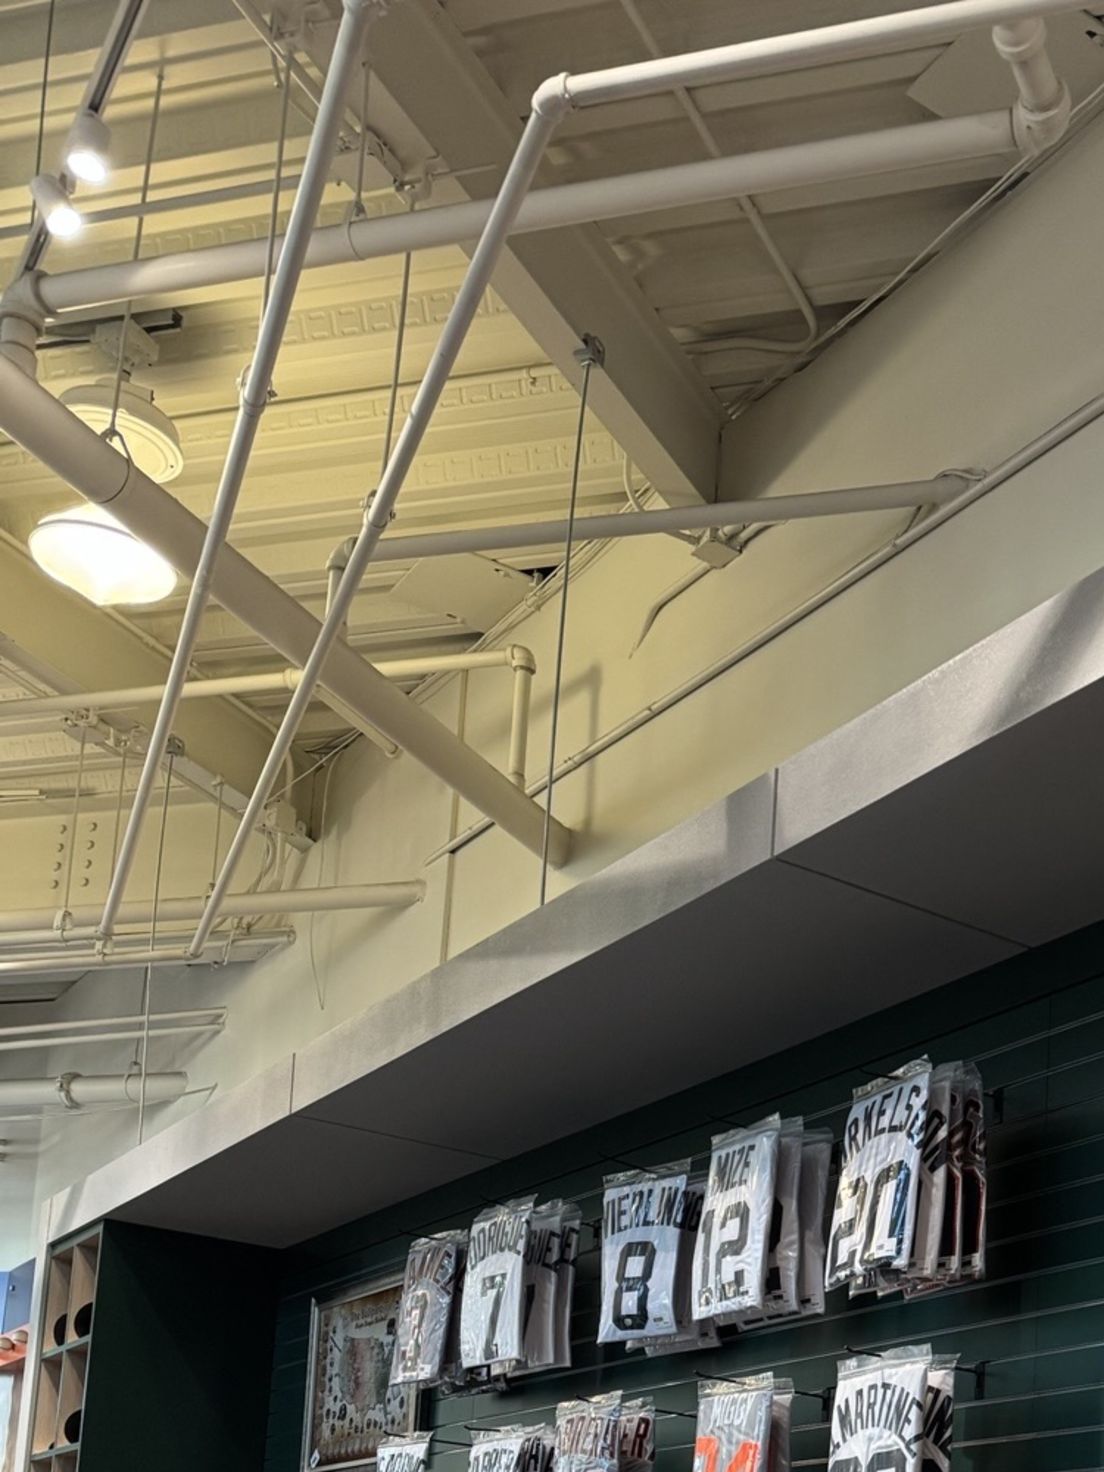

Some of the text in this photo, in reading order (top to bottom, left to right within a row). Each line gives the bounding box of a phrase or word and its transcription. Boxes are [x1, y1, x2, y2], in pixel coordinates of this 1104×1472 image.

[713, 1144, 756, 1196] MIZE
[613, 1241, 656, 1330] 8
[700, 1200, 750, 1307] 12
[481, 1272, 507, 1361] 7
[709, 1391, 757, 1428] MIGGY
